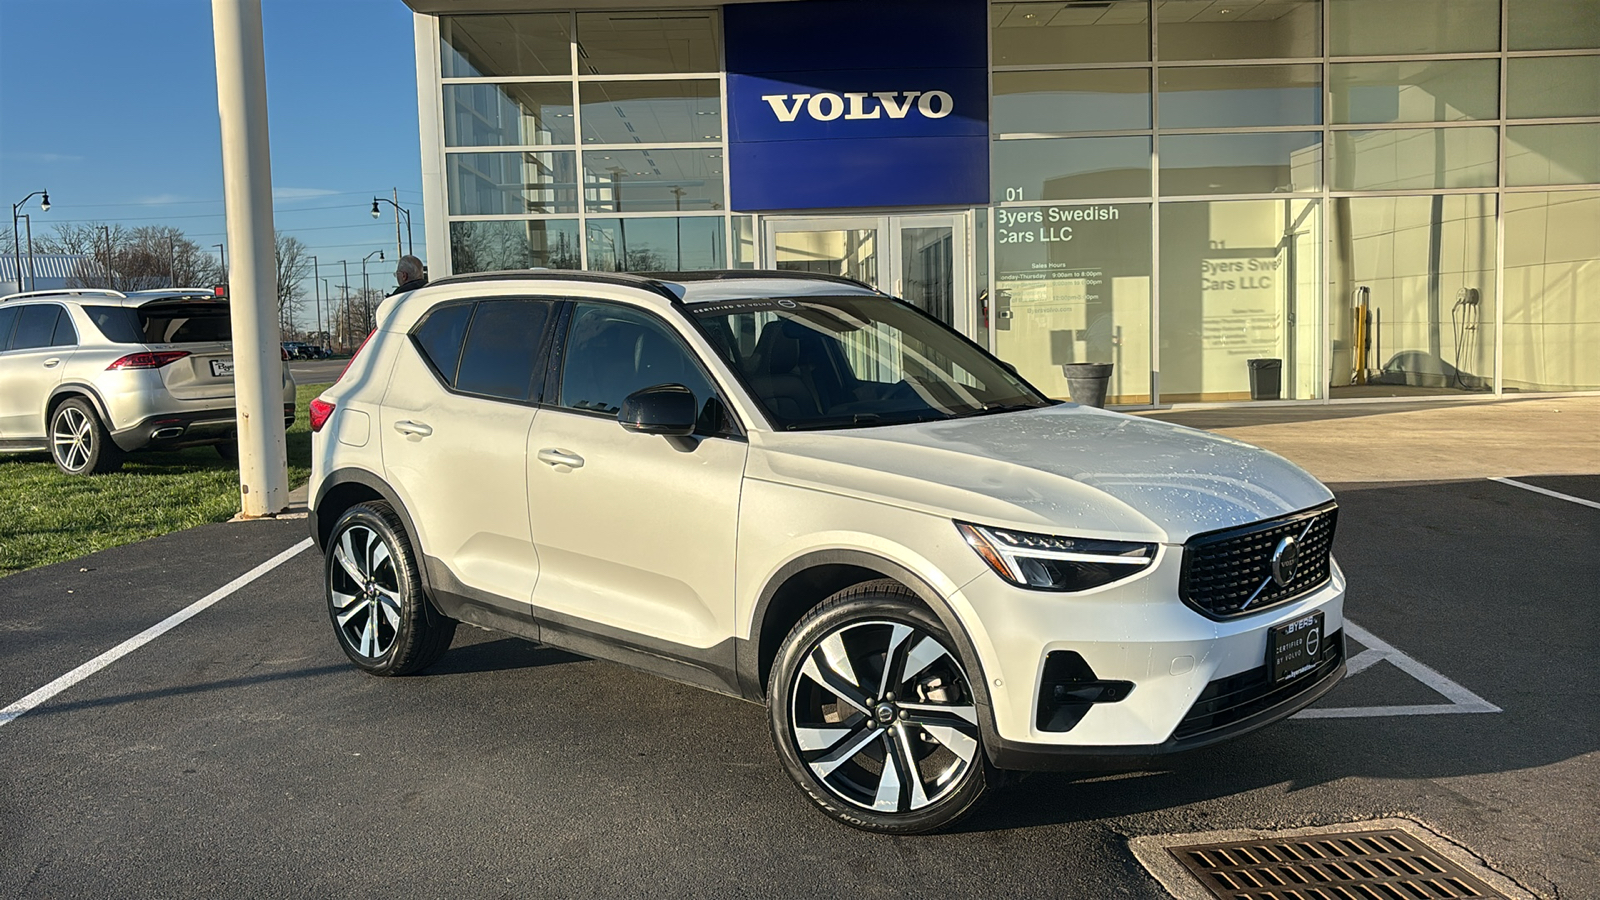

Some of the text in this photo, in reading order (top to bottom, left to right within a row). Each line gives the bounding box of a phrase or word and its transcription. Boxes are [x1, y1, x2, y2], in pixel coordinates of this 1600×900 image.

[761, 90, 954, 122] VOLVO
[999, 206, 1119, 227] Byers Swedish
[999, 227, 1073, 243] Cars LLC
[1000, 273, 1047, 281] onday-Thursday
[1240, 276, 1271, 290] LLC
[693, 305, 734, 314] CERTIFIED
[1288, 616, 1314, 633] BYERS
[1276, 638, 1303, 655] CERTIFIED
[1285, 649, 1302, 661] VOLVO
